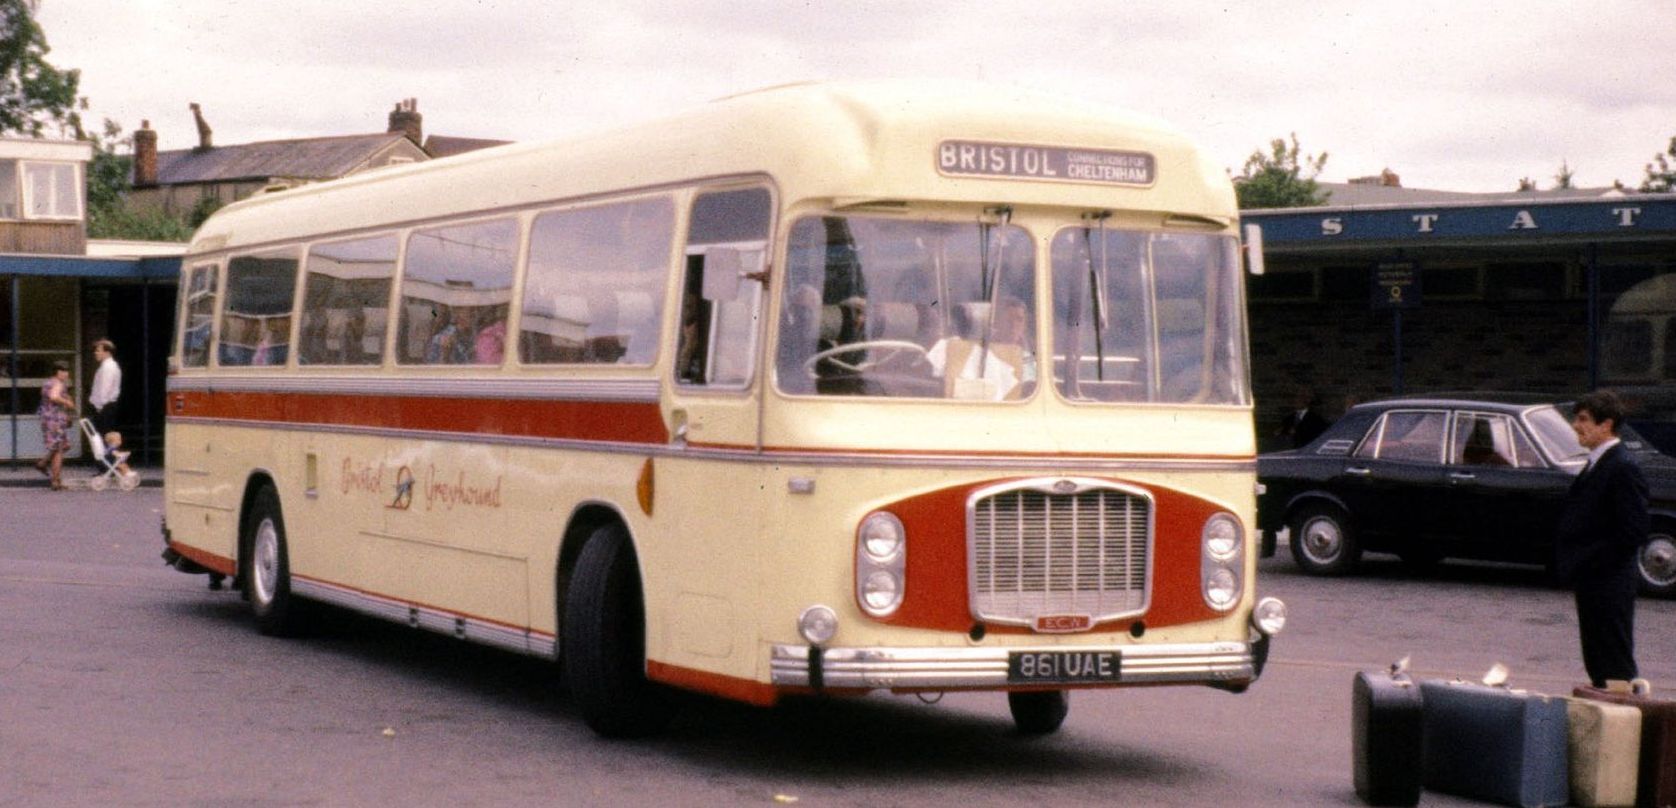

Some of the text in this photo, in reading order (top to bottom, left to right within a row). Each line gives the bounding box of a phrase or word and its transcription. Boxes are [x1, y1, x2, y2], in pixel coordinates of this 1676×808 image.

[940, 144, 1056, 176] BRISTOL
[1068, 163, 1147, 182] CHELTENHAM
[341, 456, 502, 511] Bristol Greyhound
